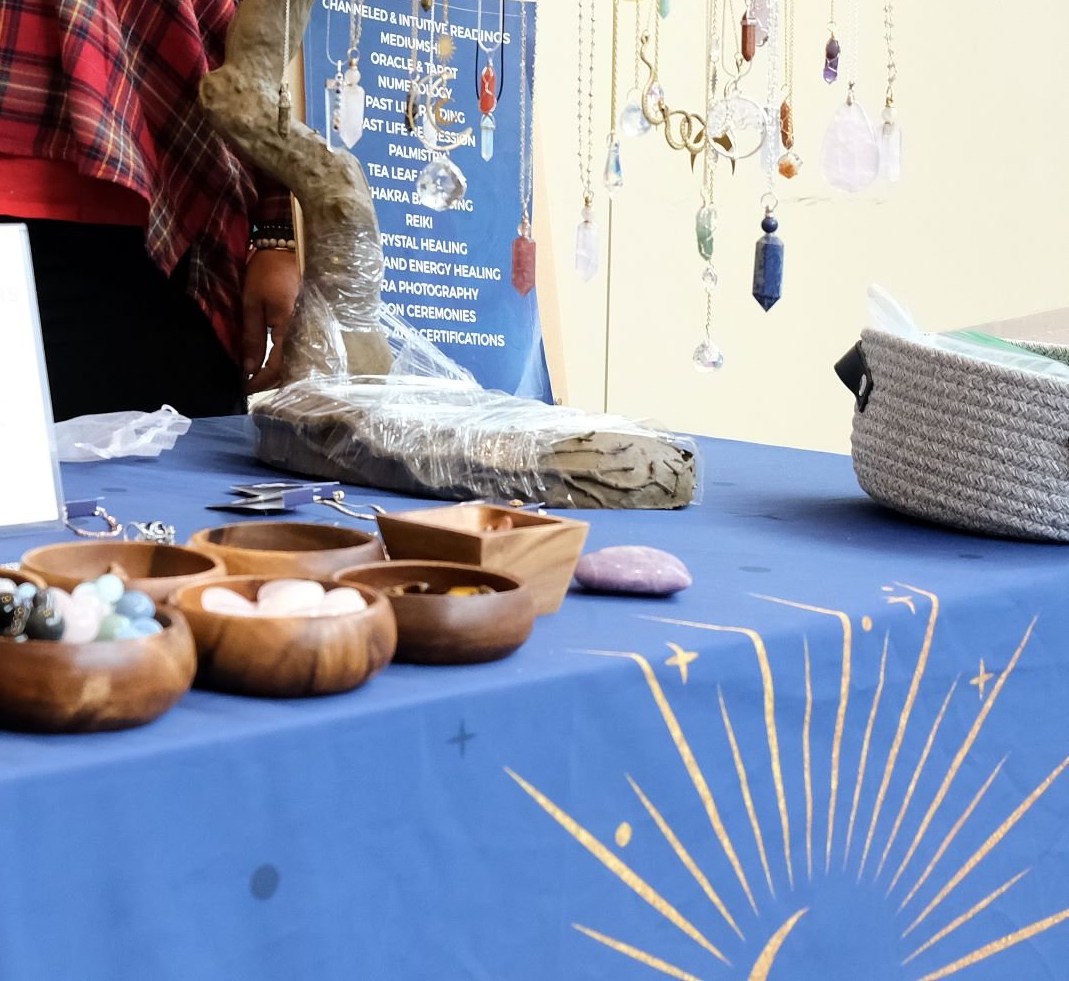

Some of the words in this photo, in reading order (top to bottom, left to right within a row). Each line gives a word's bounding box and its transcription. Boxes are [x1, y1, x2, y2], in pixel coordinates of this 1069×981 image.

[389, 12, 397, 24] &
[398, 13, 448, 36] INTUITIVE
[450, 26, 511, 44] READINGS
[380, 32, 441, 55] MEDIUMSH
[370, 51, 414, 71] ORACLE
[416, 60, 423, 73] &
[365, 95, 393, 110] PAST
[418, 105, 465, 124] RDING
[362, 117, 384, 132] AST
[386, 121, 408, 136] LIFE
[367, 163, 389, 178] TEA
[391, 166, 418, 182] LEAF
[370, 187, 410, 204] HAKRA
[406, 214, 433, 229] REIKI
[381, 233, 419, 250] RYSTAL
[421, 238, 468, 255] HEALING
[383, 256, 407, 270] AND
[409, 259, 451, 276] ENERGY
[454, 264, 501, 281] HEALING
[399, 281, 479, 300] PHOTOGRAPHY
[407, 305, 476, 323] CEREMONIES
[420, 329, 506, 347] CERTIFICATIONS
